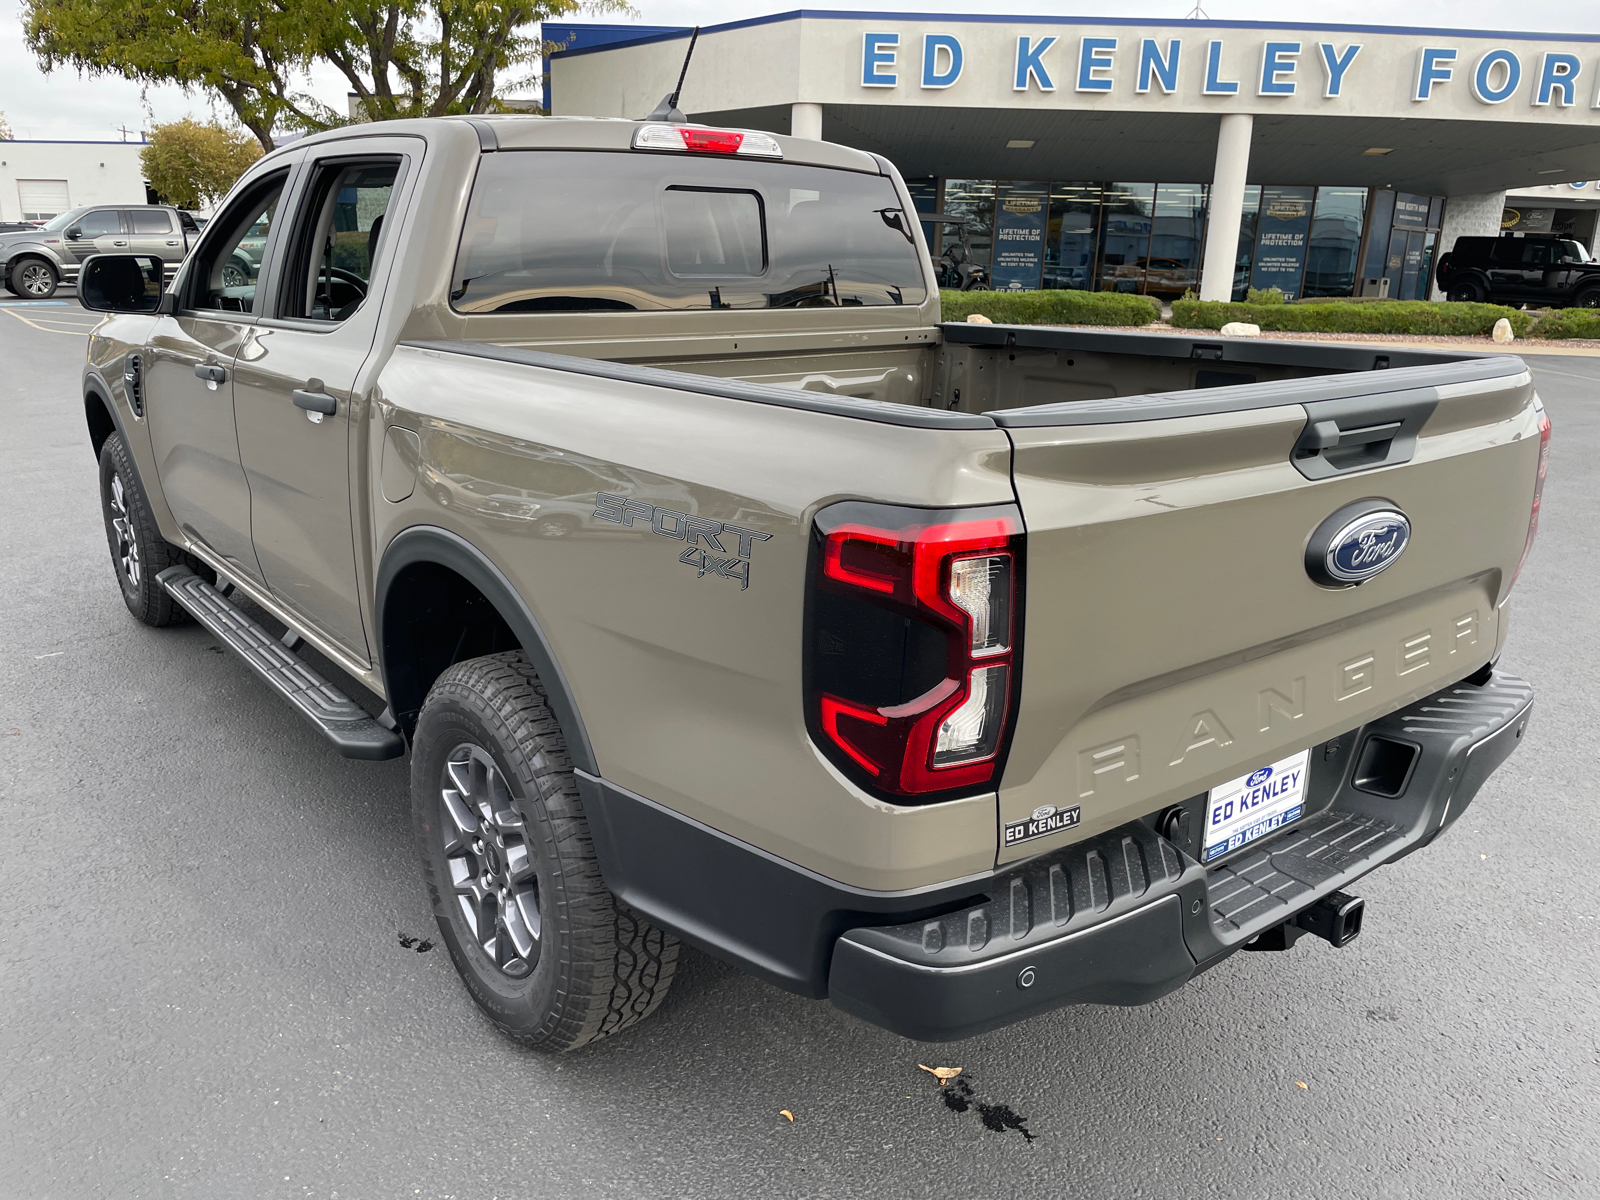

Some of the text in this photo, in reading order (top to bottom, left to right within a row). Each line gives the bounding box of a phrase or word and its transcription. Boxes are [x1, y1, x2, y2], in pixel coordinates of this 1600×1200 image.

[861, 32, 1600, 108] ED KENLEY FOR
[593, 491, 773, 559] SPORT
[1351, 526, 1398, 567] Ford
[1077, 609, 1480, 798] RANGER
[1006, 809, 1080, 841] ED KENLEY
[1212, 800, 1234, 825] ED
[1239, 769, 1301, 813] KENLEY
[1228, 833, 1243, 848] ED
[1244, 812, 1286, 842] KENLEY
